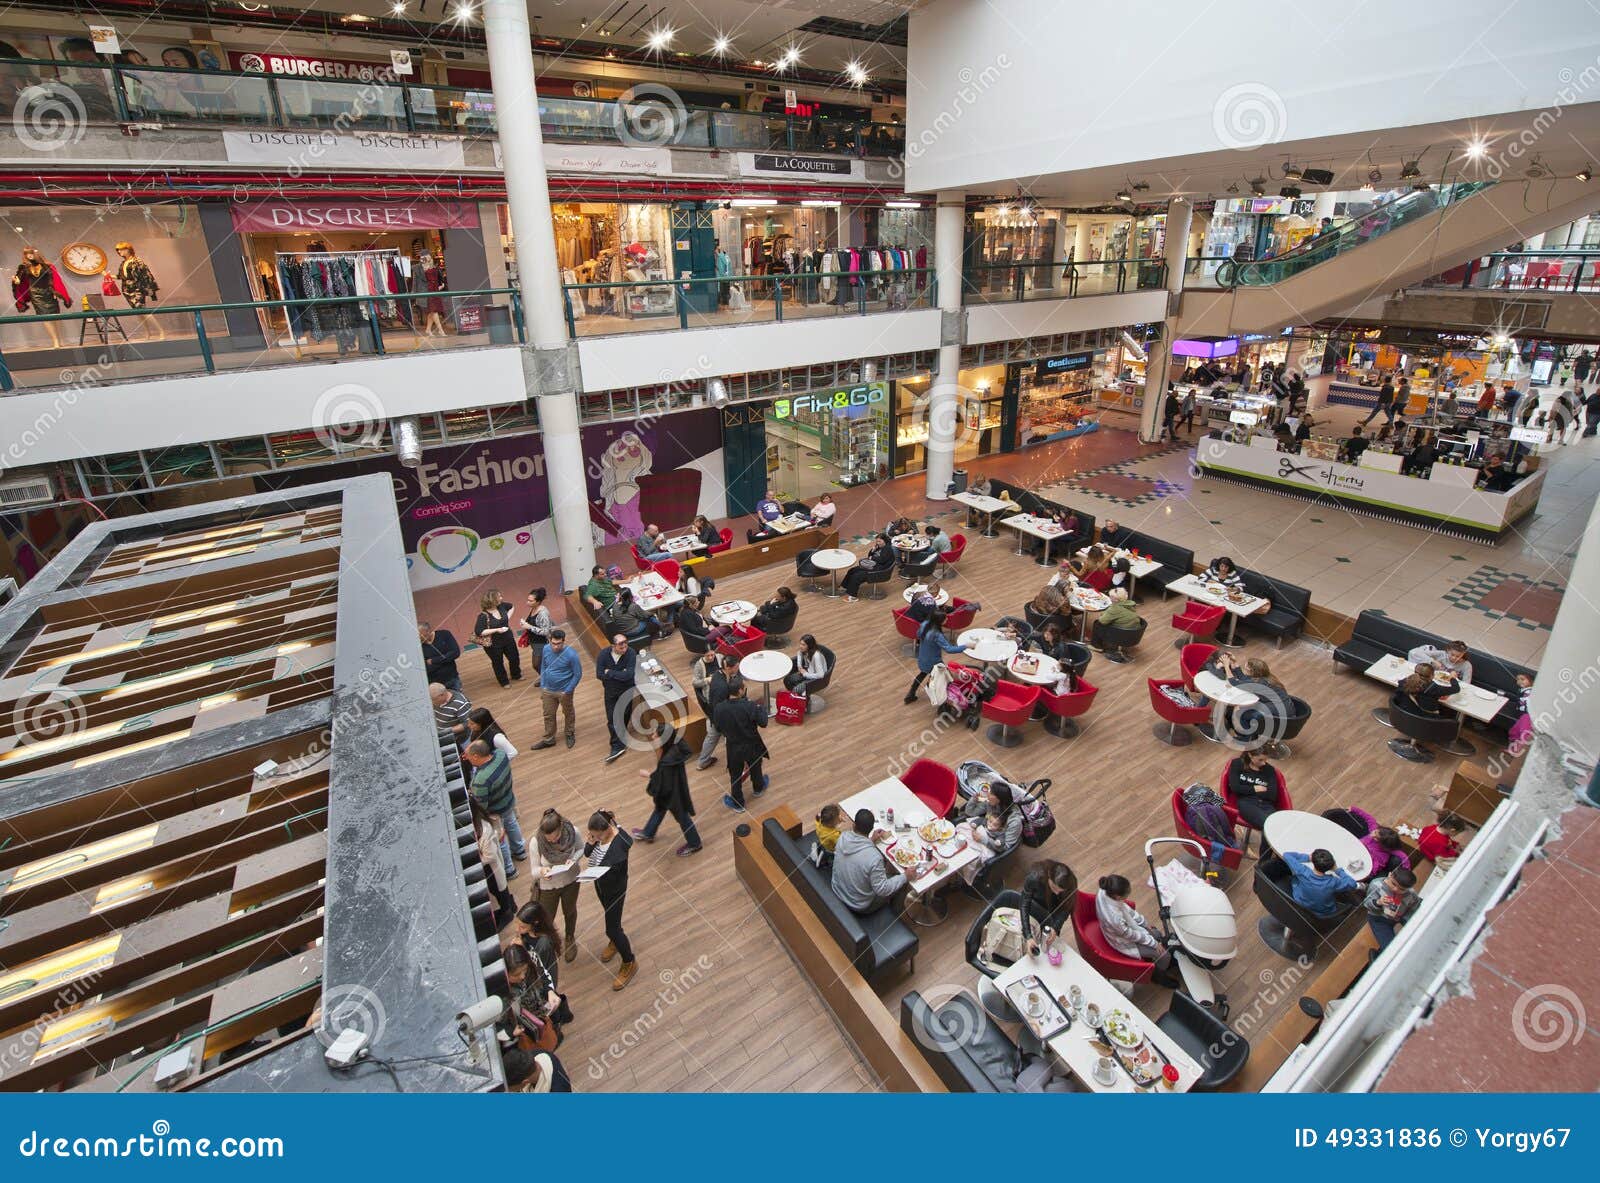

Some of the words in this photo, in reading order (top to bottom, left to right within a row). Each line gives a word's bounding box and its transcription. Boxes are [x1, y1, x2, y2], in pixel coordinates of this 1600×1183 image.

[775, 157, 789, 168] LA
[789, 159, 837, 171] COQUETTE
[271, 208, 417, 226] DISCREET
[793, 387, 884, 417] Fix&Go
[415, 503, 450, 517] Coming
[450, 500, 472, 512] Soon
[780, 705, 799, 714] FOX
